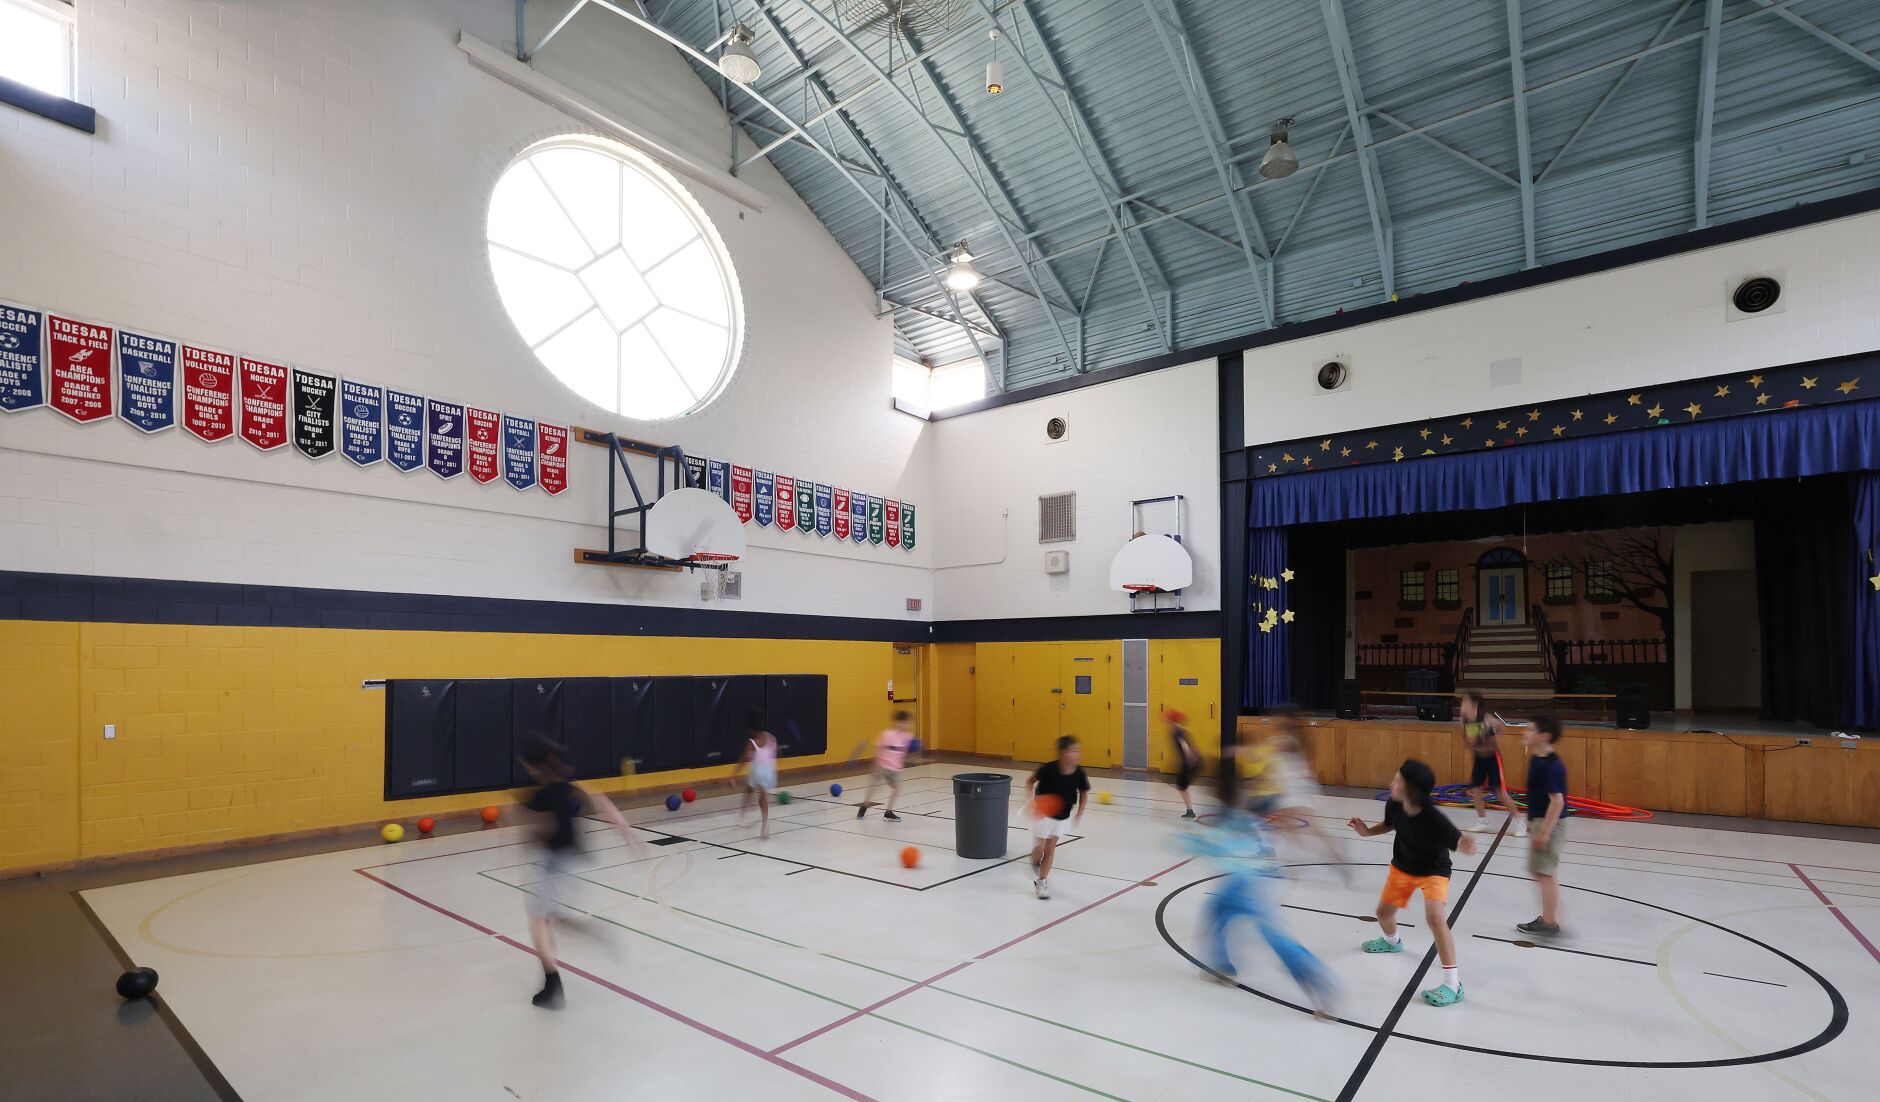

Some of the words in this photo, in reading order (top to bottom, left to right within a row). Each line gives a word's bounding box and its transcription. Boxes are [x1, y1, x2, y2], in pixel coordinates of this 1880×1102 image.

[0, 308, 36, 326] ESAA
[0, 321, 27, 333] CCER
[53, 319, 108, 340] TDESAA
[53, 332, 78, 344] TRACK
[80, 338, 86, 346] &
[88, 340, 108, 350] FIELD
[122, 334, 172, 354] TDESAA
[122, 346, 171, 364] BASKETBALL
[185, 348, 230, 366] TDESAA
[0, 362, 32, 372] ALISTS
[70, 364, 93, 375] AREA
[185, 360, 230, 375] VOLLEYBALL
[243, 361, 284, 378] TDESAA
[0, 370, 19, 379] ADE
[56, 368, 105, 384] CHAMPIONS
[250, 373, 277, 385] HOCKEY
[64, 381, 90, 392] GRADE
[124, 373, 171, 389] CONFERENCE
[296, 373, 333, 390] TDESAA
[61, 387, 101, 399] COMBINED
[127, 382, 167, 396] FINALISTS
[186, 385, 229, 400] CONFERENCE
[302, 386, 326, 397] HOCKEY
[343, 382, 379, 398] TDESAA
[61, 396, 78, 405] 2007
[85, 400, 102, 408] 2008
[131, 393, 156, 403] GRADE
[187, 392, 228, 406] CHAMPIONS
[244, 397, 284, 411] CONFERENCE
[344, 394, 379, 406] VOLLEYBALL
[389, 392, 422, 407] TDESAA
[137, 401, 157, 410] BOYS
[194, 404, 216, 414] GRADE
[245, 404, 283, 417] CHAMPIONS
[394, 404, 417, 414] SOCCER
[431, 402, 461, 416] TDESAA
[199, 412, 218, 420] GIRLS
[253, 415, 273, 424] GRADE
[298, 414, 330, 427] FINALISTS
[306, 410, 321, 419] CITY
[468, 408, 497, 421] TDESAA
[344, 416, 379, 429] CONFERENCE
[474, 419, 492, 428] SOCCER
[505, 417, 532, 430] TDESAA
[304, 425, 322, 434] GRADE
[346, 424, 377, 434] FINALISTS
[388, 424, 421, 436] CONFERENCE
[540, 425, 566, 438] TDESAA
[350, 432, 368, 441] GRADE
[391, 432, 419, 442] FINALISTS
[430, 433, 461, 444] CONFERENCE
[431, 439, 461, 450] CHAMPIONS
[470, 438, 496, 450] CONFERENCE
[506, 447, 533, 457] CONFERENCE
